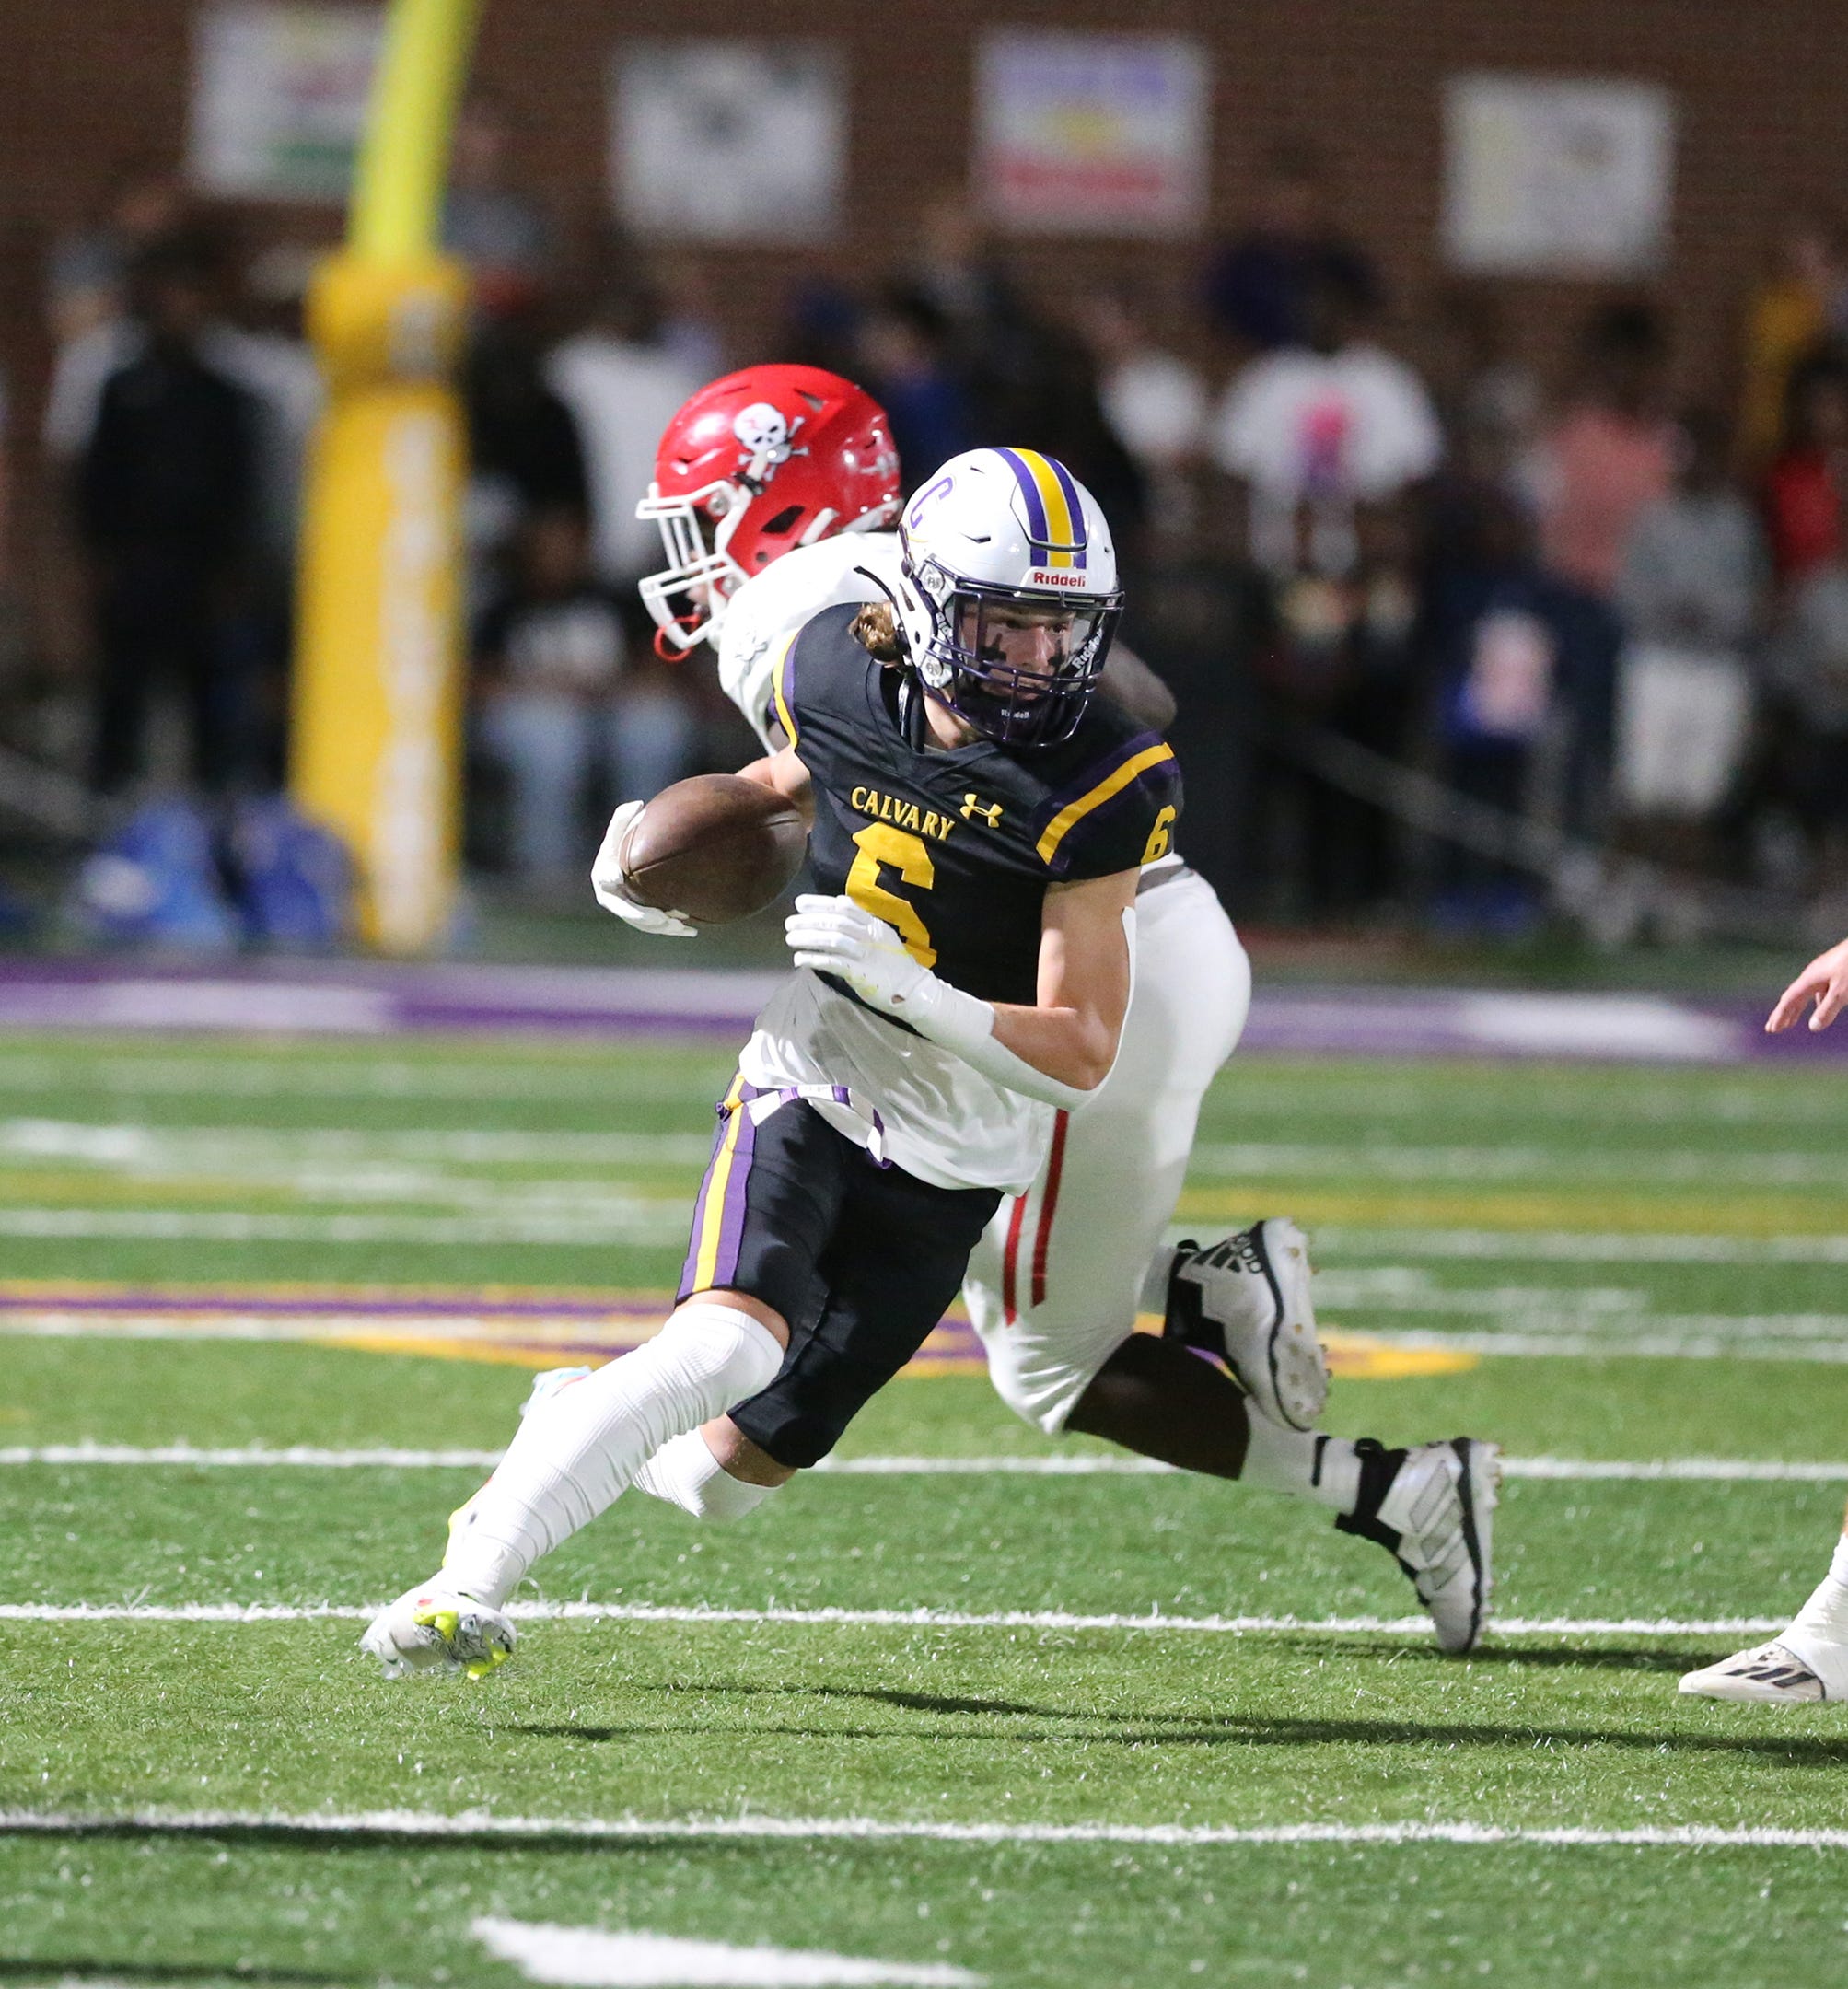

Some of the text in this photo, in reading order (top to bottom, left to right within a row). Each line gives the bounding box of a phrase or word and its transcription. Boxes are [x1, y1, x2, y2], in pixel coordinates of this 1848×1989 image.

[910, 476, 954, 529] C
[1033, 571, 1087, 587] Riddell
[851, 785, 956, 842] CALVARY
[1141, 804, 1176, 865] 6
[844, 820, 937, 970] 6
